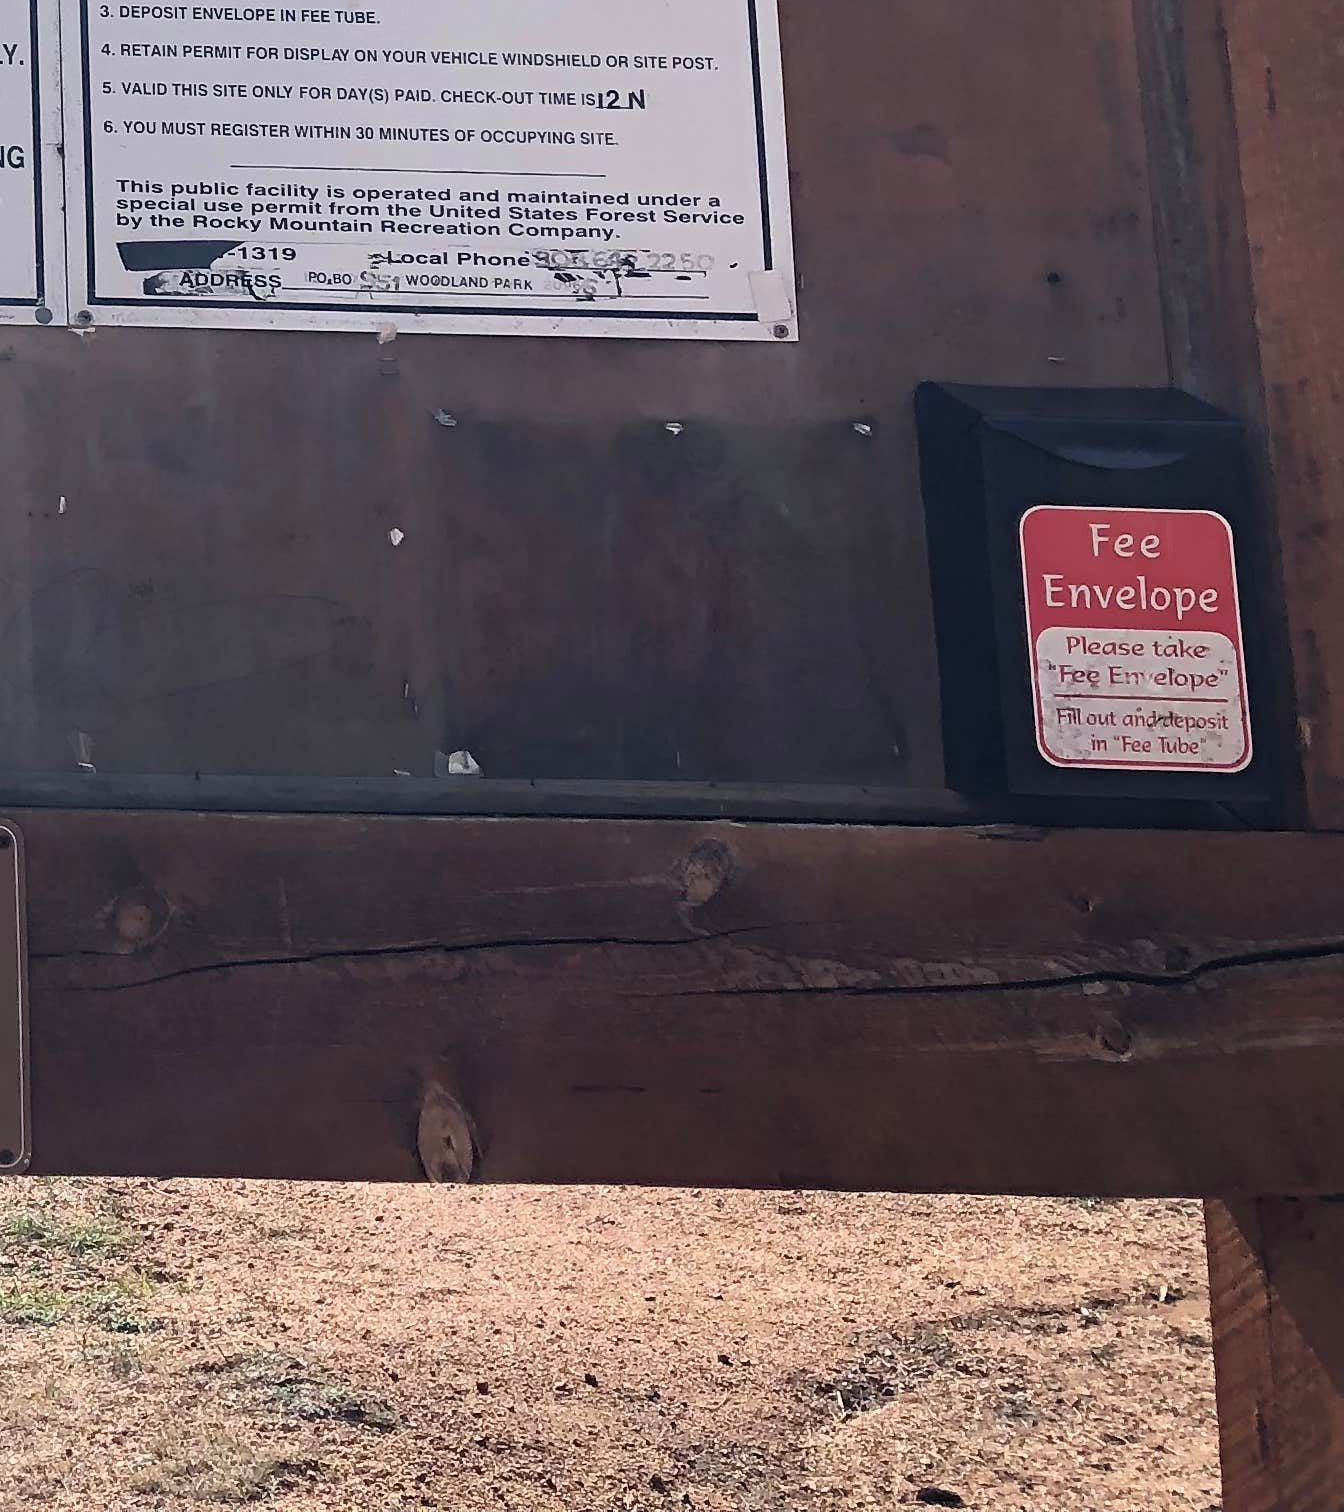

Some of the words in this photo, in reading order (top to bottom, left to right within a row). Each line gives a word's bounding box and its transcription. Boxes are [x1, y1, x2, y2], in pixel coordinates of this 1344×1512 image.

[100, 4, 113, 17] 3.
[119, 5, 187, 19] DEPOSIT
[192, 7, 275, 21] ENVELOPE
[280, 8, 295, 22] IN
[301, 9, 330, 22] FEE
[334, 10, 380, 24] TUBE.
[116, 212, 142, 229] by
[149, 213, 184, 227] the
[193, 214, 261, 232] Rocky
[270, 217, 372, 232] Mountain
[381, 220, 500, 235] Recreation
[508, 222, 620, 241] Company.
[1089, 523, 1161, 558] Fee
[1042, 574, 1219, 620] Envelope
[1066, 636, 1145, 656] Please
[1152, 638, 1210, 658] take
[1056, 707, 1082, 726] Fill
[1086, 710, 1117, 727] out
[1123, 710, 1159, 728] and
[1162, 710, 1229, 732] deposit
[1091, 734, 1108, 752] in
[1114, 735, 1152, 753] "Fee
[1159, 736, 1207, 755] Tube"
